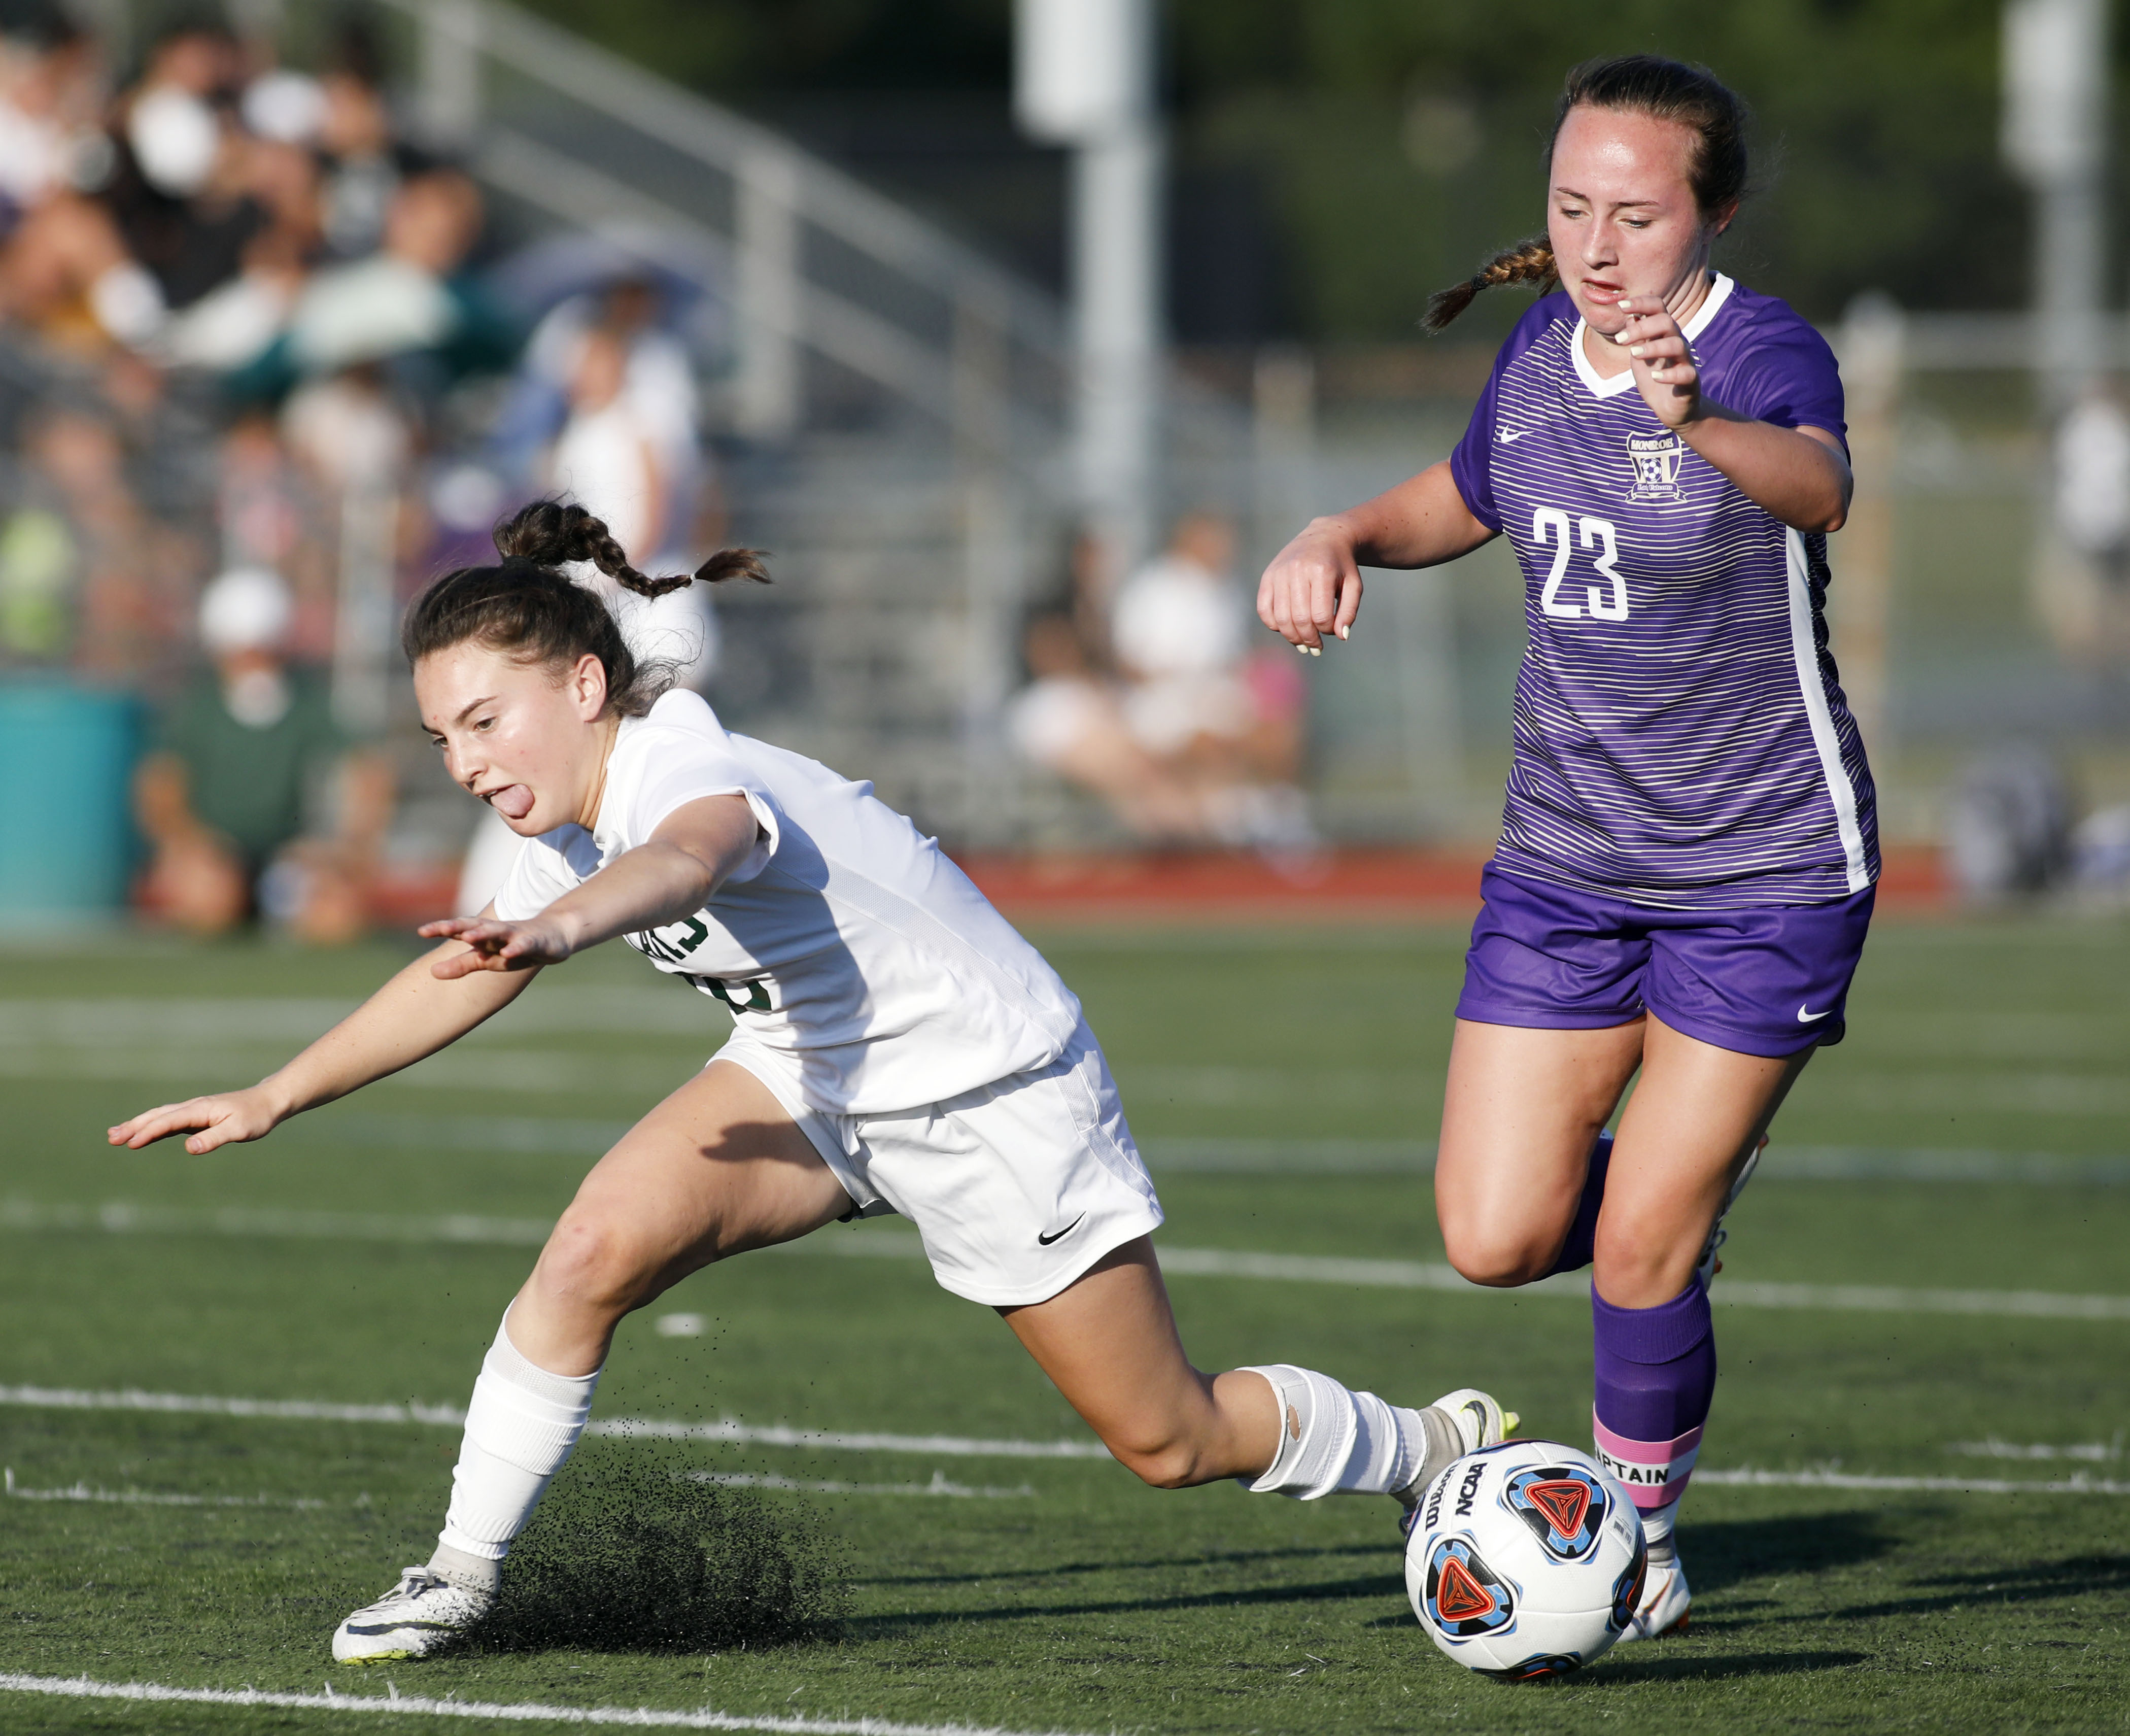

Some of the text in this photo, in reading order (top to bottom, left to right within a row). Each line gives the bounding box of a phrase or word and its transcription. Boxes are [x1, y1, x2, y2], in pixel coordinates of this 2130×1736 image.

[1631, 437, 1673, 450] MONROE
[1533, 507, 1628, 621] 23
[1425, 1461, 1461, 1532] Wilson
[1455, 1462, 1488, 1516] NCAA
